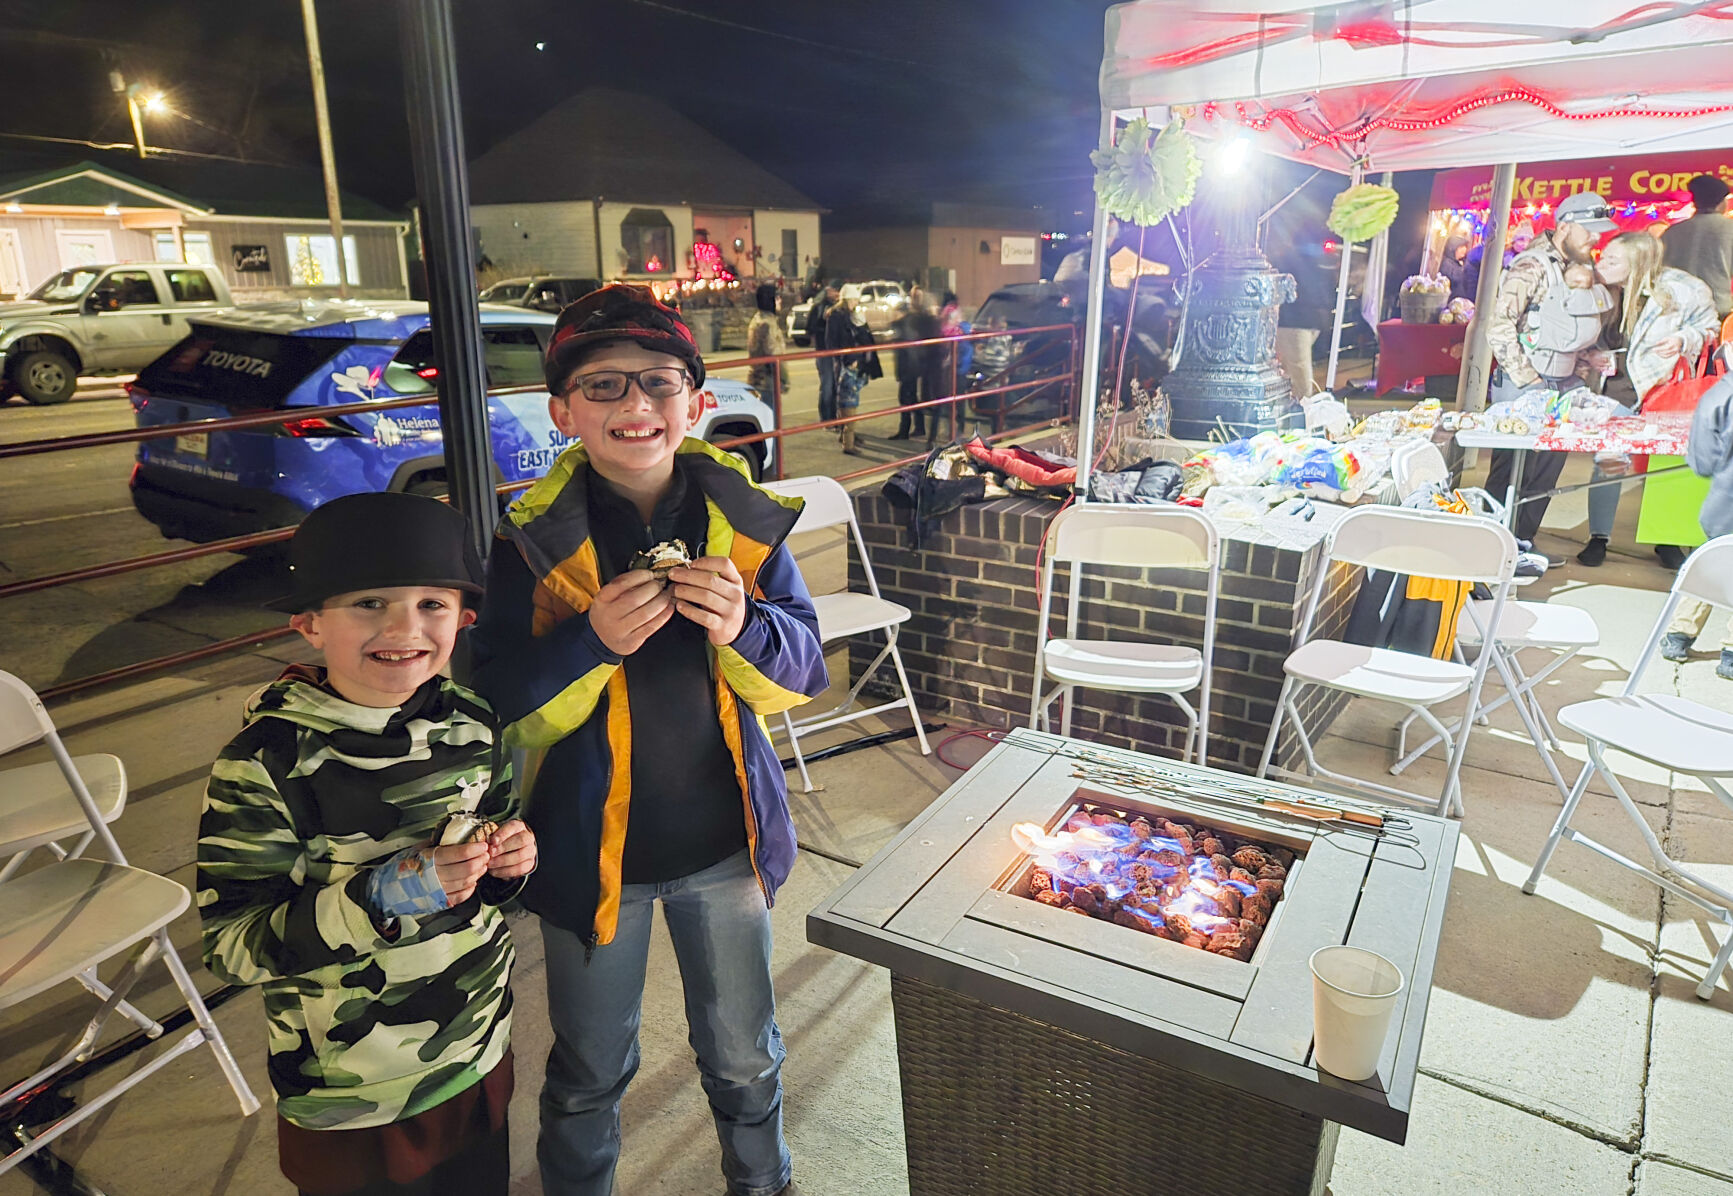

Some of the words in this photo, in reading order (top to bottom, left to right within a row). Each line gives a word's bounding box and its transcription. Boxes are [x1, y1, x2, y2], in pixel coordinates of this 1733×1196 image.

[1512, 176, 1613, 200] KETTLE
[1629, 170, 1713, 194] COR
[202, 350, 272, 378] TOYOTA
[716, 394, 745, 402] TOYOTA
[397, 416, 440, 429] Helena
[519, 450, 549, 469] EAST
